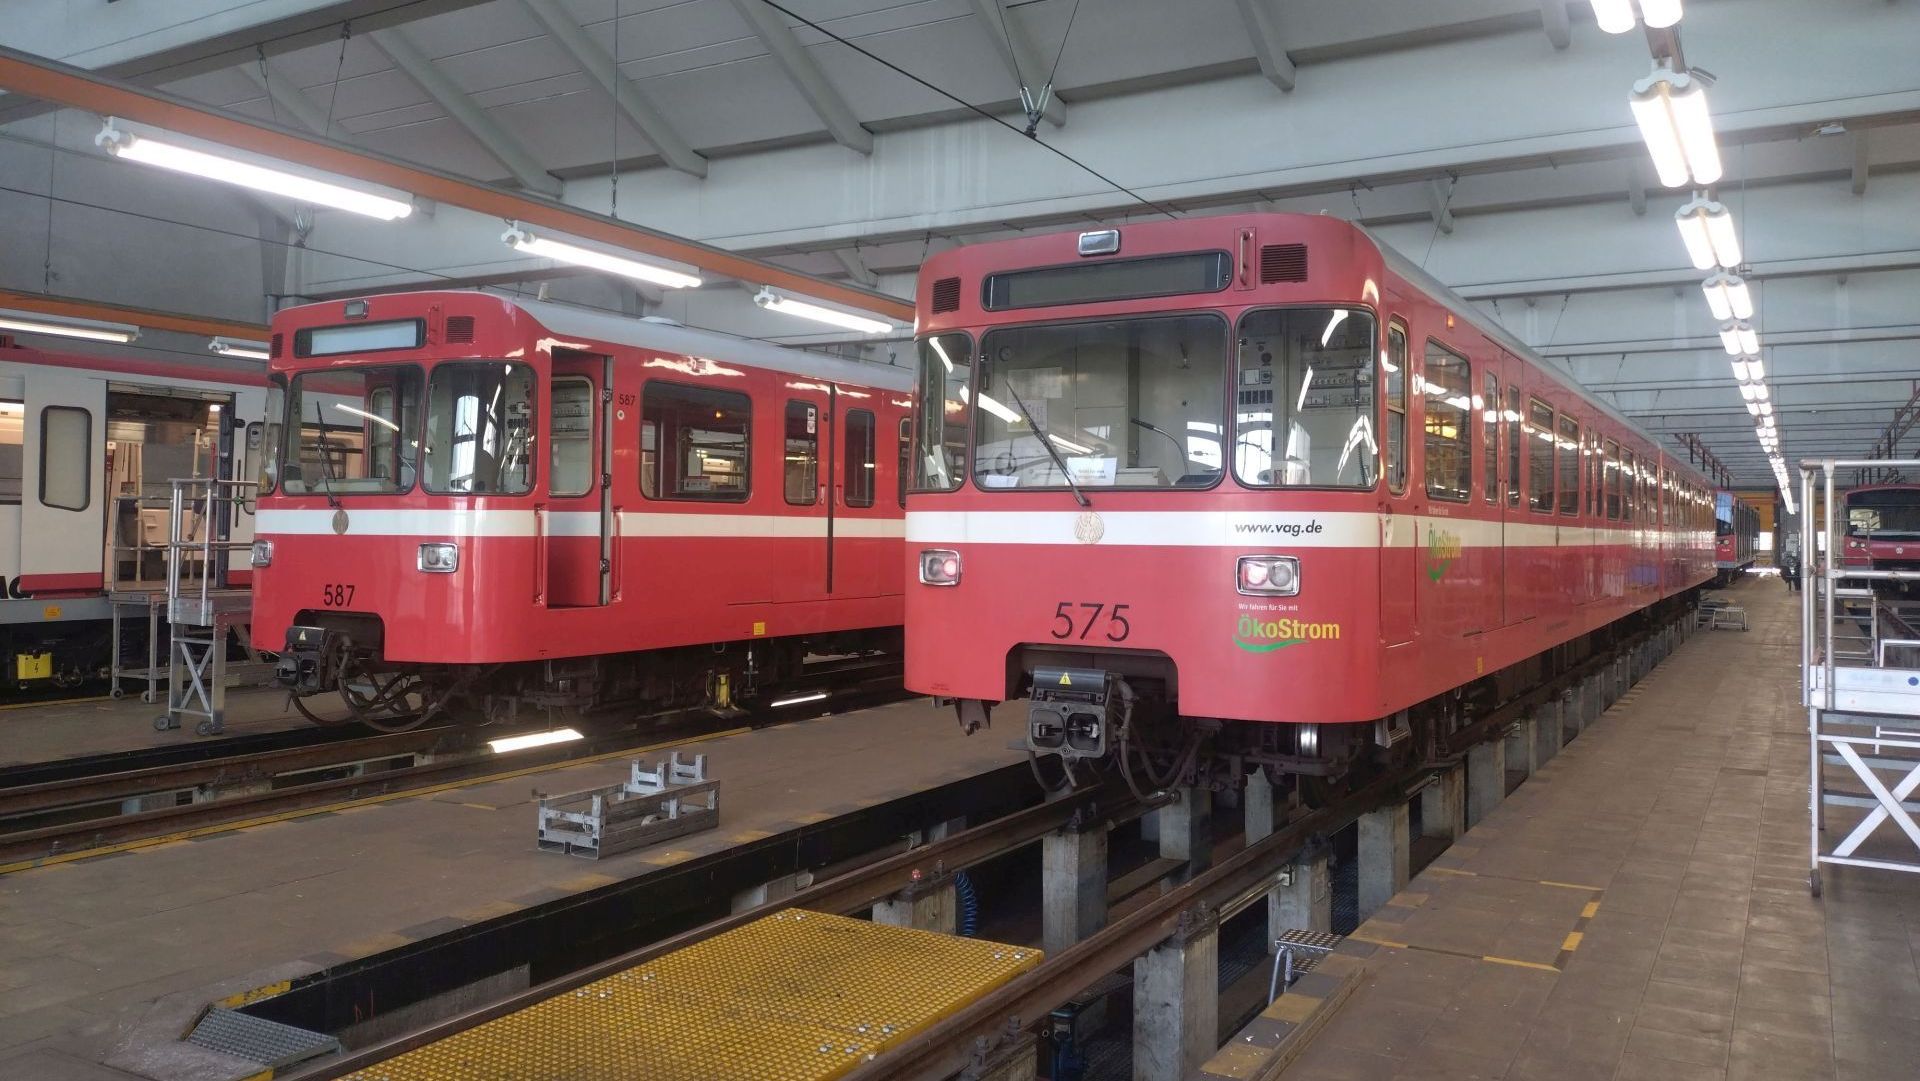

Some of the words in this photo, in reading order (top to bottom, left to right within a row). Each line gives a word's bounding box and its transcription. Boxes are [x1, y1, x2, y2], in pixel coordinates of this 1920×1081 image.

[619, 393, 636, 406] 587
[1234, 519, 1323, 537] www.vag.de
[323, 583, 356, 607] 587
[1238, 603, 1249, 611] Wir
[1249, 603, 1268, 611] fahren
[1268, 603, 1278, 611] für
[1278, 604, 1288, 612] Sie
[1288, 604, 1299, 612] mit
[1051, 602, 1130, 642] 575
[1237, 613, 1341, 640] ÖkoStrom
